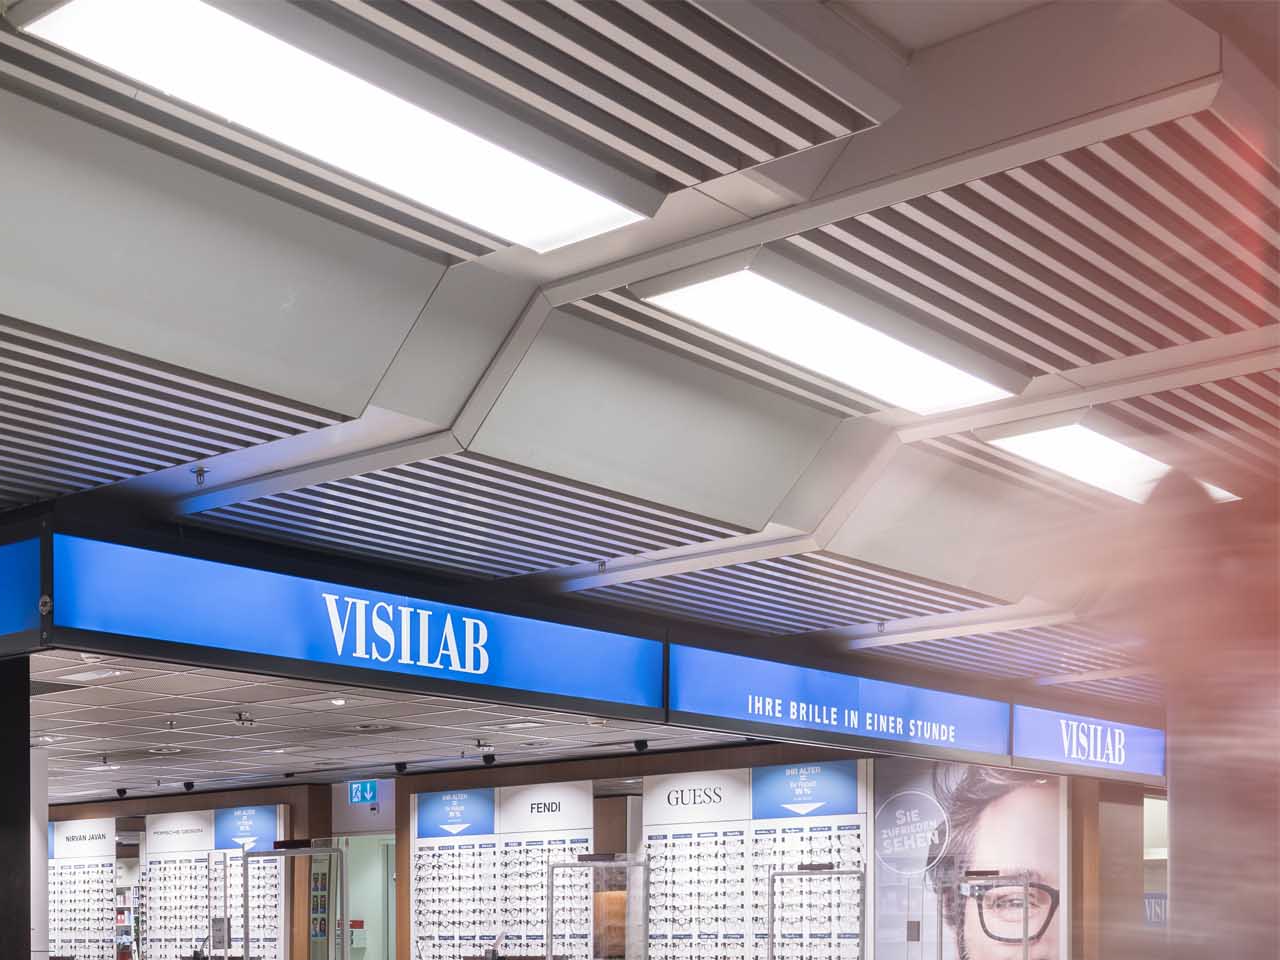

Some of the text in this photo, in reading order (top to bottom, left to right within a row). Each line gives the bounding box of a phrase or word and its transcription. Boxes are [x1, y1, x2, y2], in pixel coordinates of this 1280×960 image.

[321, 593, 490, 675] VISILAB
[748, 694, 956, 743] IHRE BRILLE IN EINER STUNDE
[1060, 719, 1125, 765] VISILAB
[530, 801, 561, 814] FENDI
[667, 787, 722, 807] GUESS
[88, 833, 106, 841] JAVAN
[883, 830, 939, 854] SEHEN
